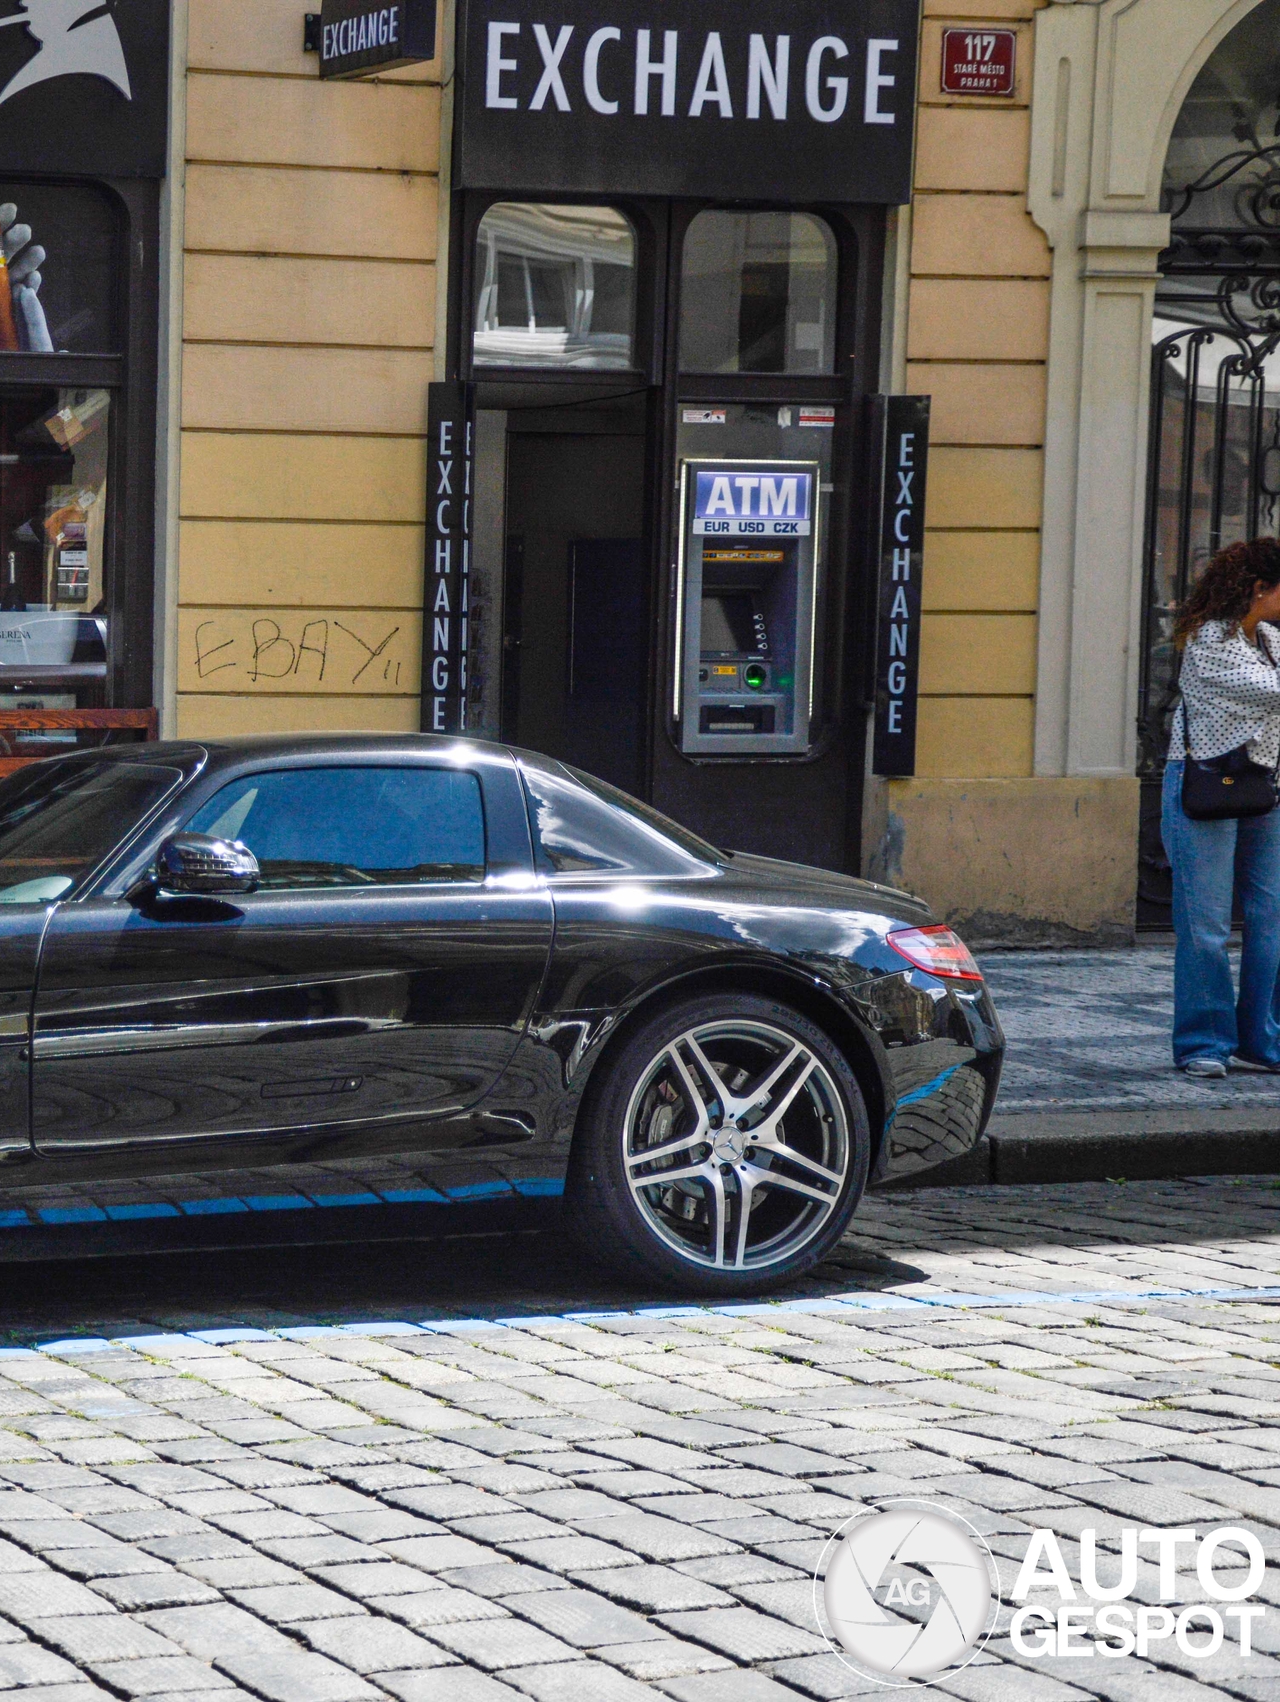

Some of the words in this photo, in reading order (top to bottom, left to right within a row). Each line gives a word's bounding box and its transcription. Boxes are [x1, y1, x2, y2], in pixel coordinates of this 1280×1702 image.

[322, 5, 399, 60] EXCHANGE
[964, 35, 996, 61] 117
[485, 21, 899, 124] EXCHANGE
[953, 62, 978, 74] STARÉ
[961, 77, 991, 88] PRAHA
[993, 78, 997, 88] 1
[705, 477, 798, 516] ATM
[704, 521, 730, 532] EUR
[738, 522, 765, 533] USD
[773, 522, 798, 534] CZK
[432, 421, 453, 730] EXCHANGE
[888, 433, 915, 733] EXCHANGE
